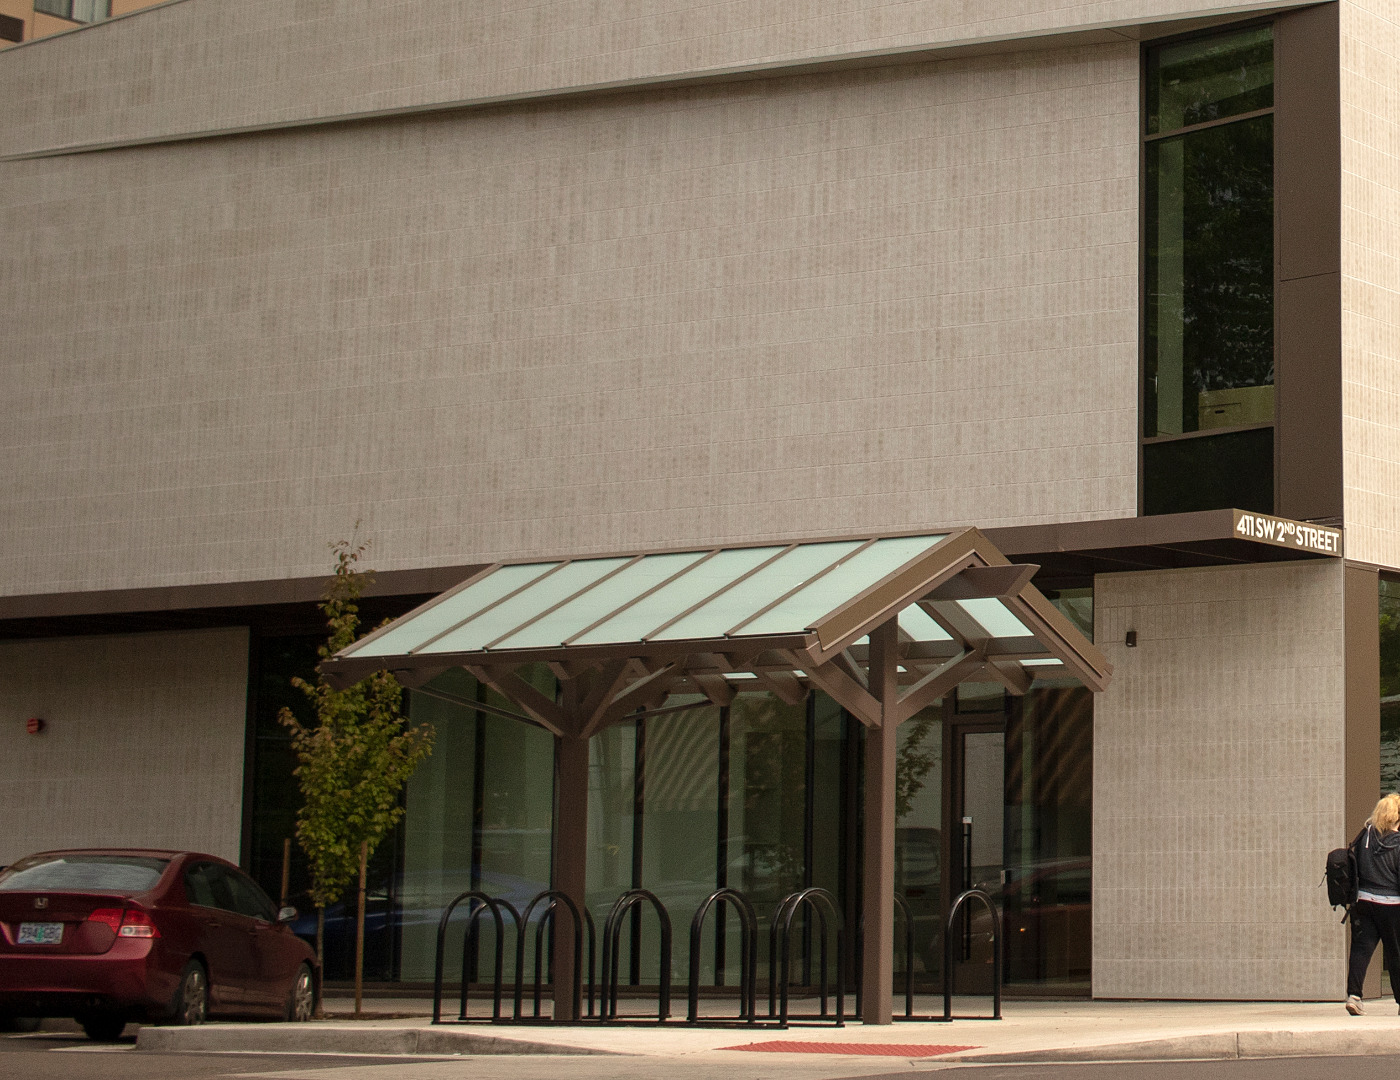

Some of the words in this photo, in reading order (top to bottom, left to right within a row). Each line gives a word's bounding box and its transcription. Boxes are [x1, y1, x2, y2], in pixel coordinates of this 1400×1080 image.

[1237, 515, 1254, 537] 411
[1256, 517, 1275, 540] SW
[1276, 522, 1295, 542] 2ND
[1296, 526, 1339, 552] STREET
